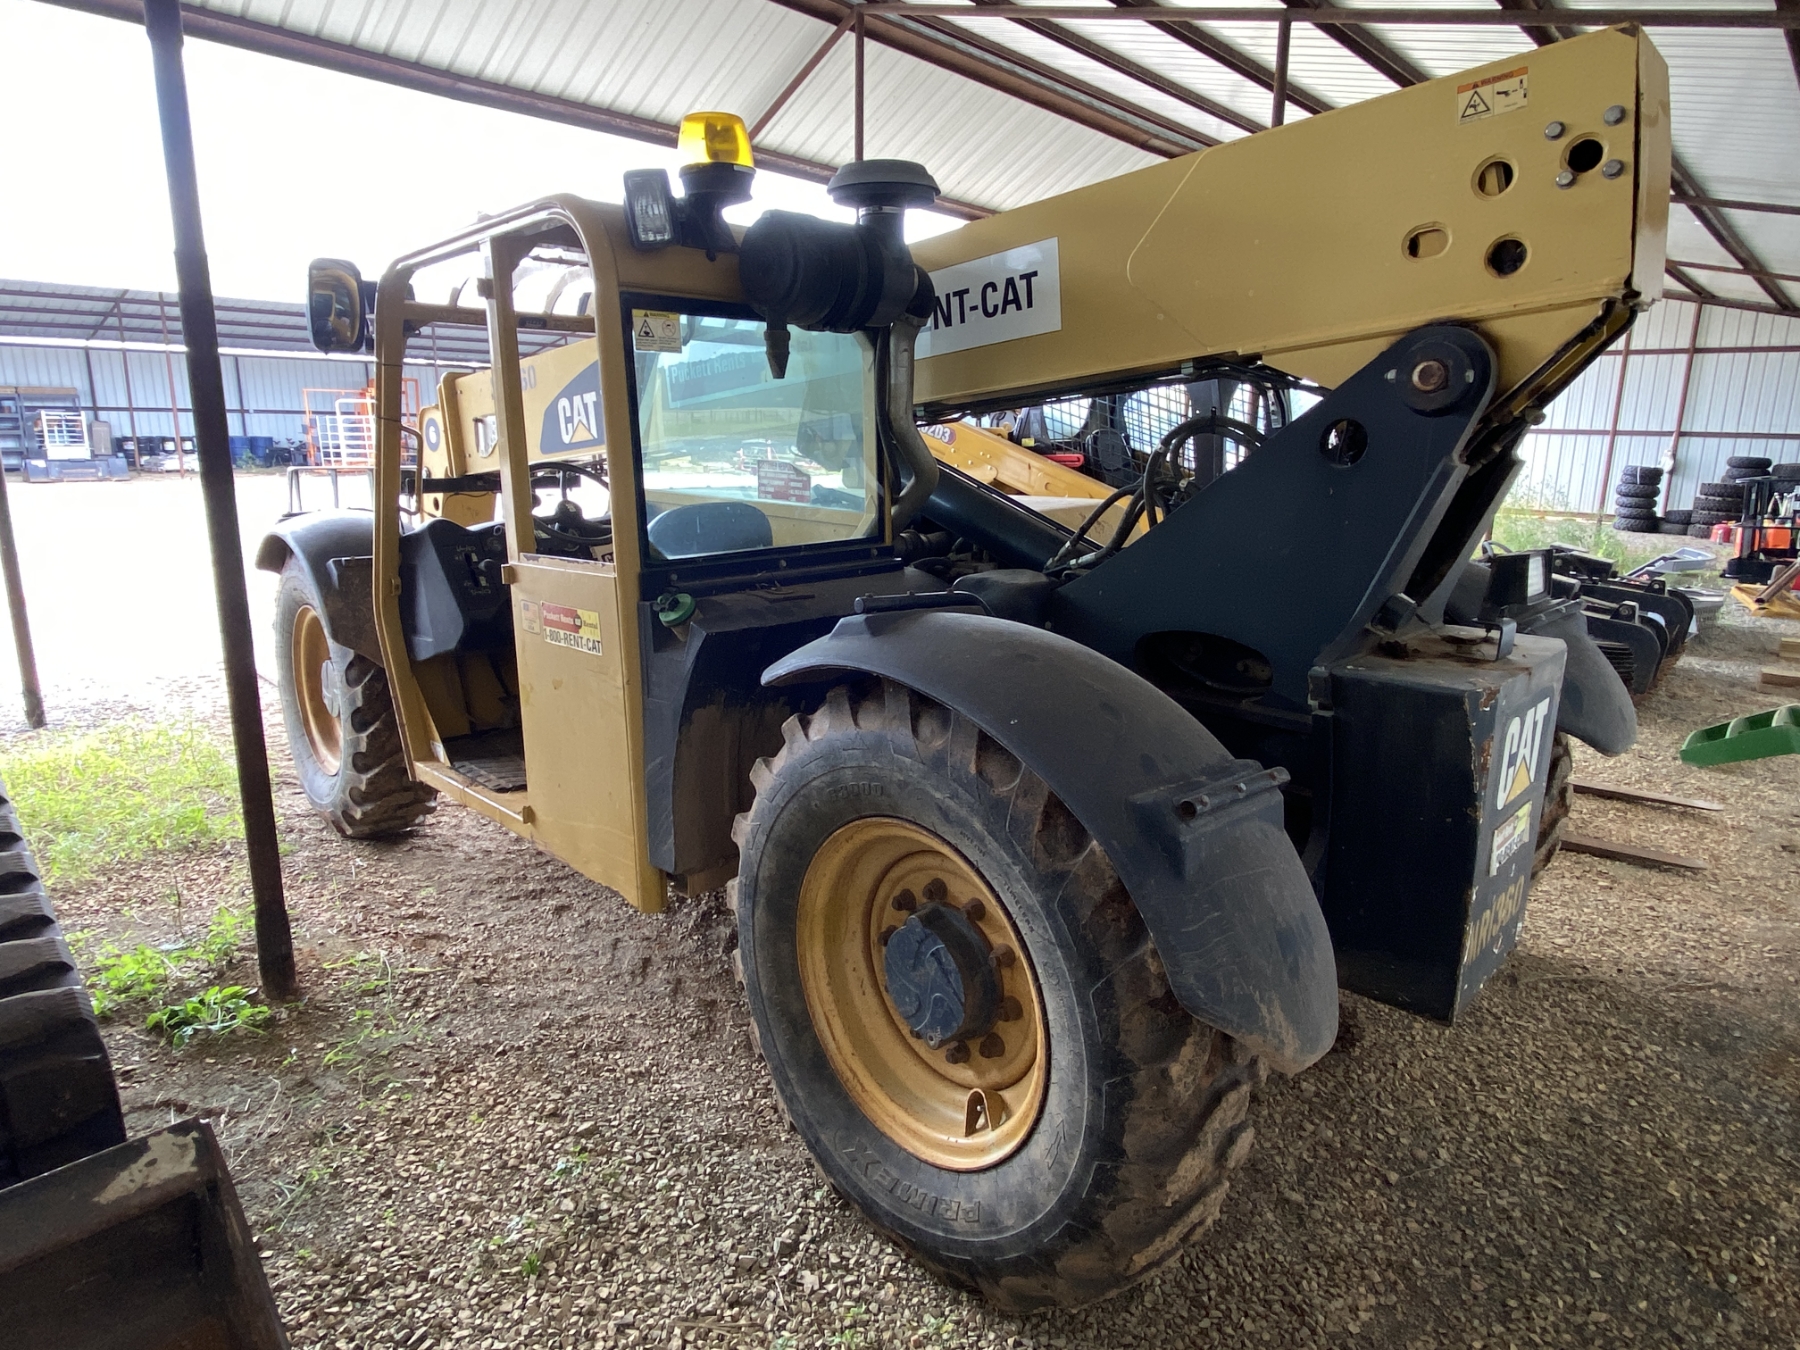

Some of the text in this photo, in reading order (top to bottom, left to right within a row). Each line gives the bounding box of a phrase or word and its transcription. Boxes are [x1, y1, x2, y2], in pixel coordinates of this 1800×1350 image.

[670, 355, 746, 384] Puckett Rents
[428, 425, 437, 444] 6
[557, 391, 598, 445] CAT
[543, 628, 601, 654] 1-800-RENT-CAT
[1497, 697, 1550, 810] CAT
[843, 1137, 980, 1223] PRIMEX
